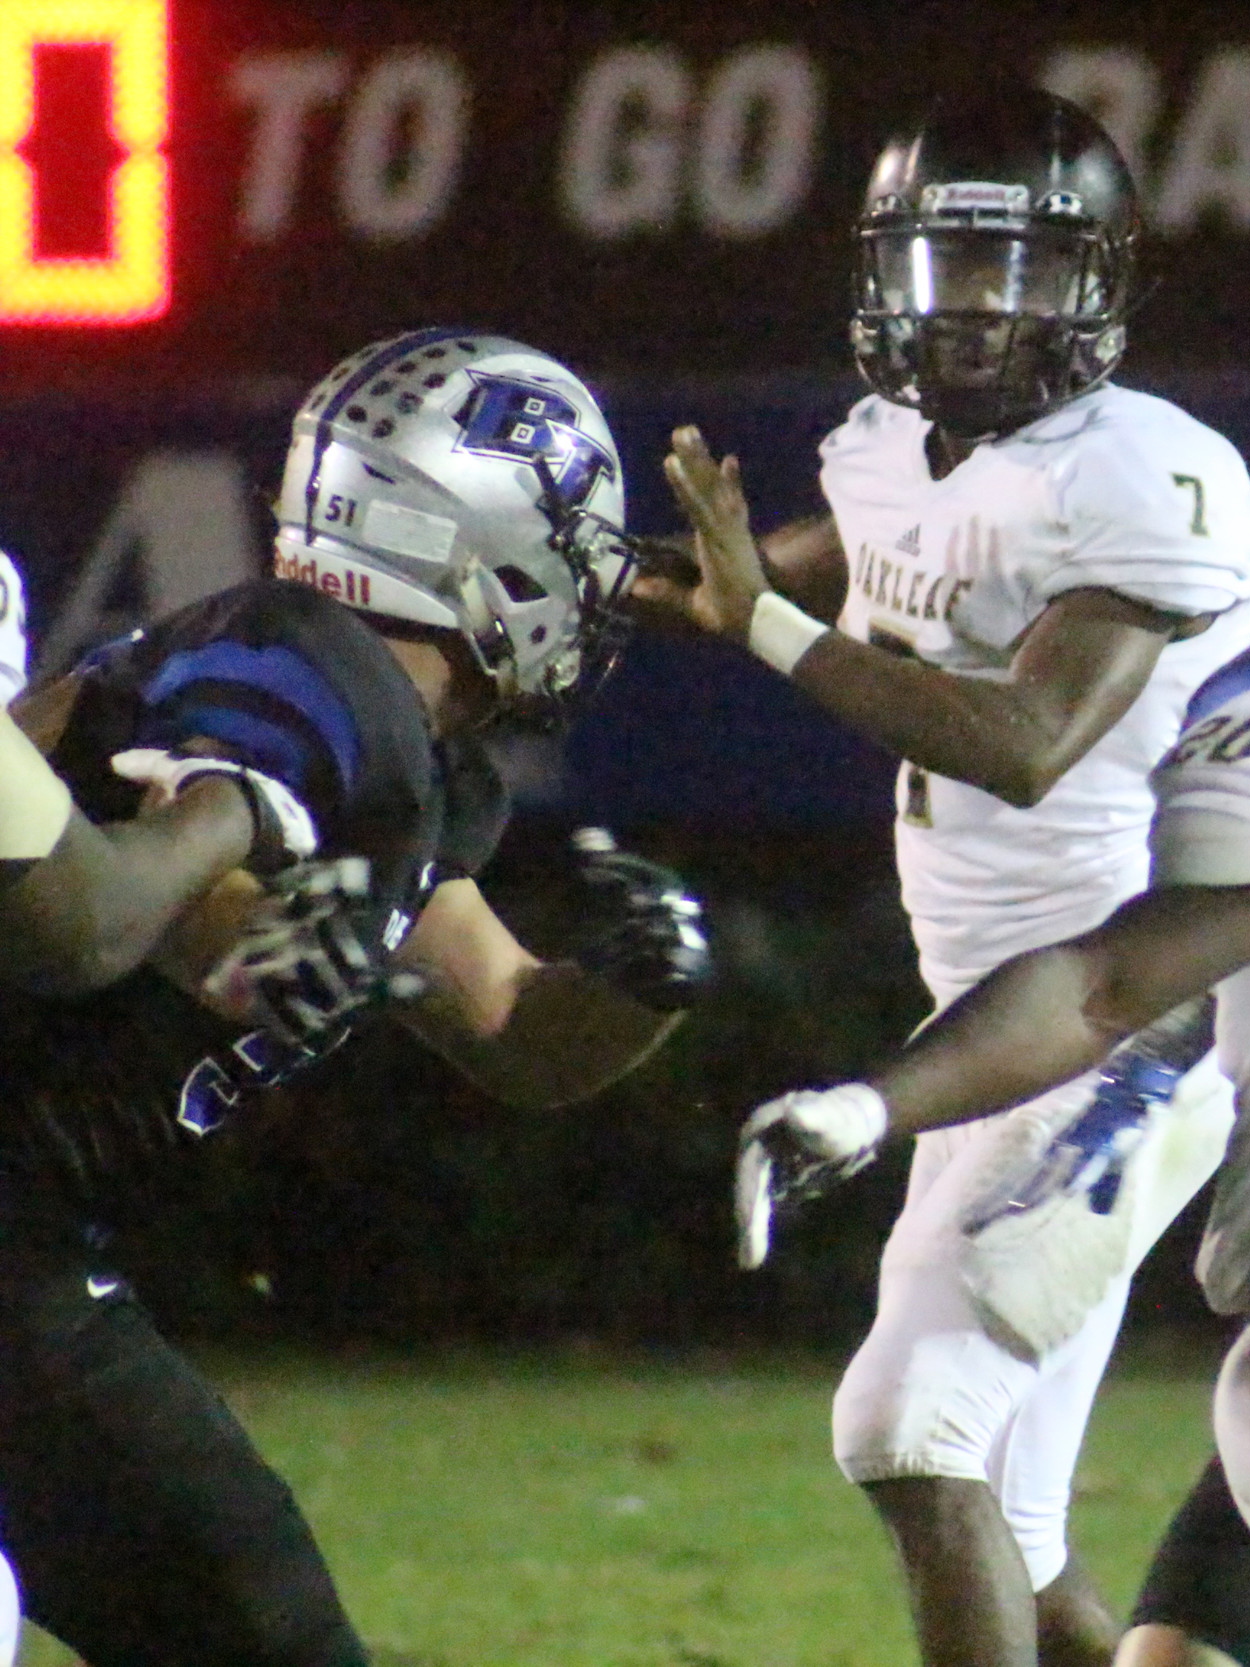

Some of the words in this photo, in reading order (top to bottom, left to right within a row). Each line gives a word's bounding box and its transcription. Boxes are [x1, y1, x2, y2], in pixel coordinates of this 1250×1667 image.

[229, 46, 467, 240] TO
[565, 44, 821, 238] GO
[325, 494, 359, 527] 51
[1168, 471, 1212, 539] 7
